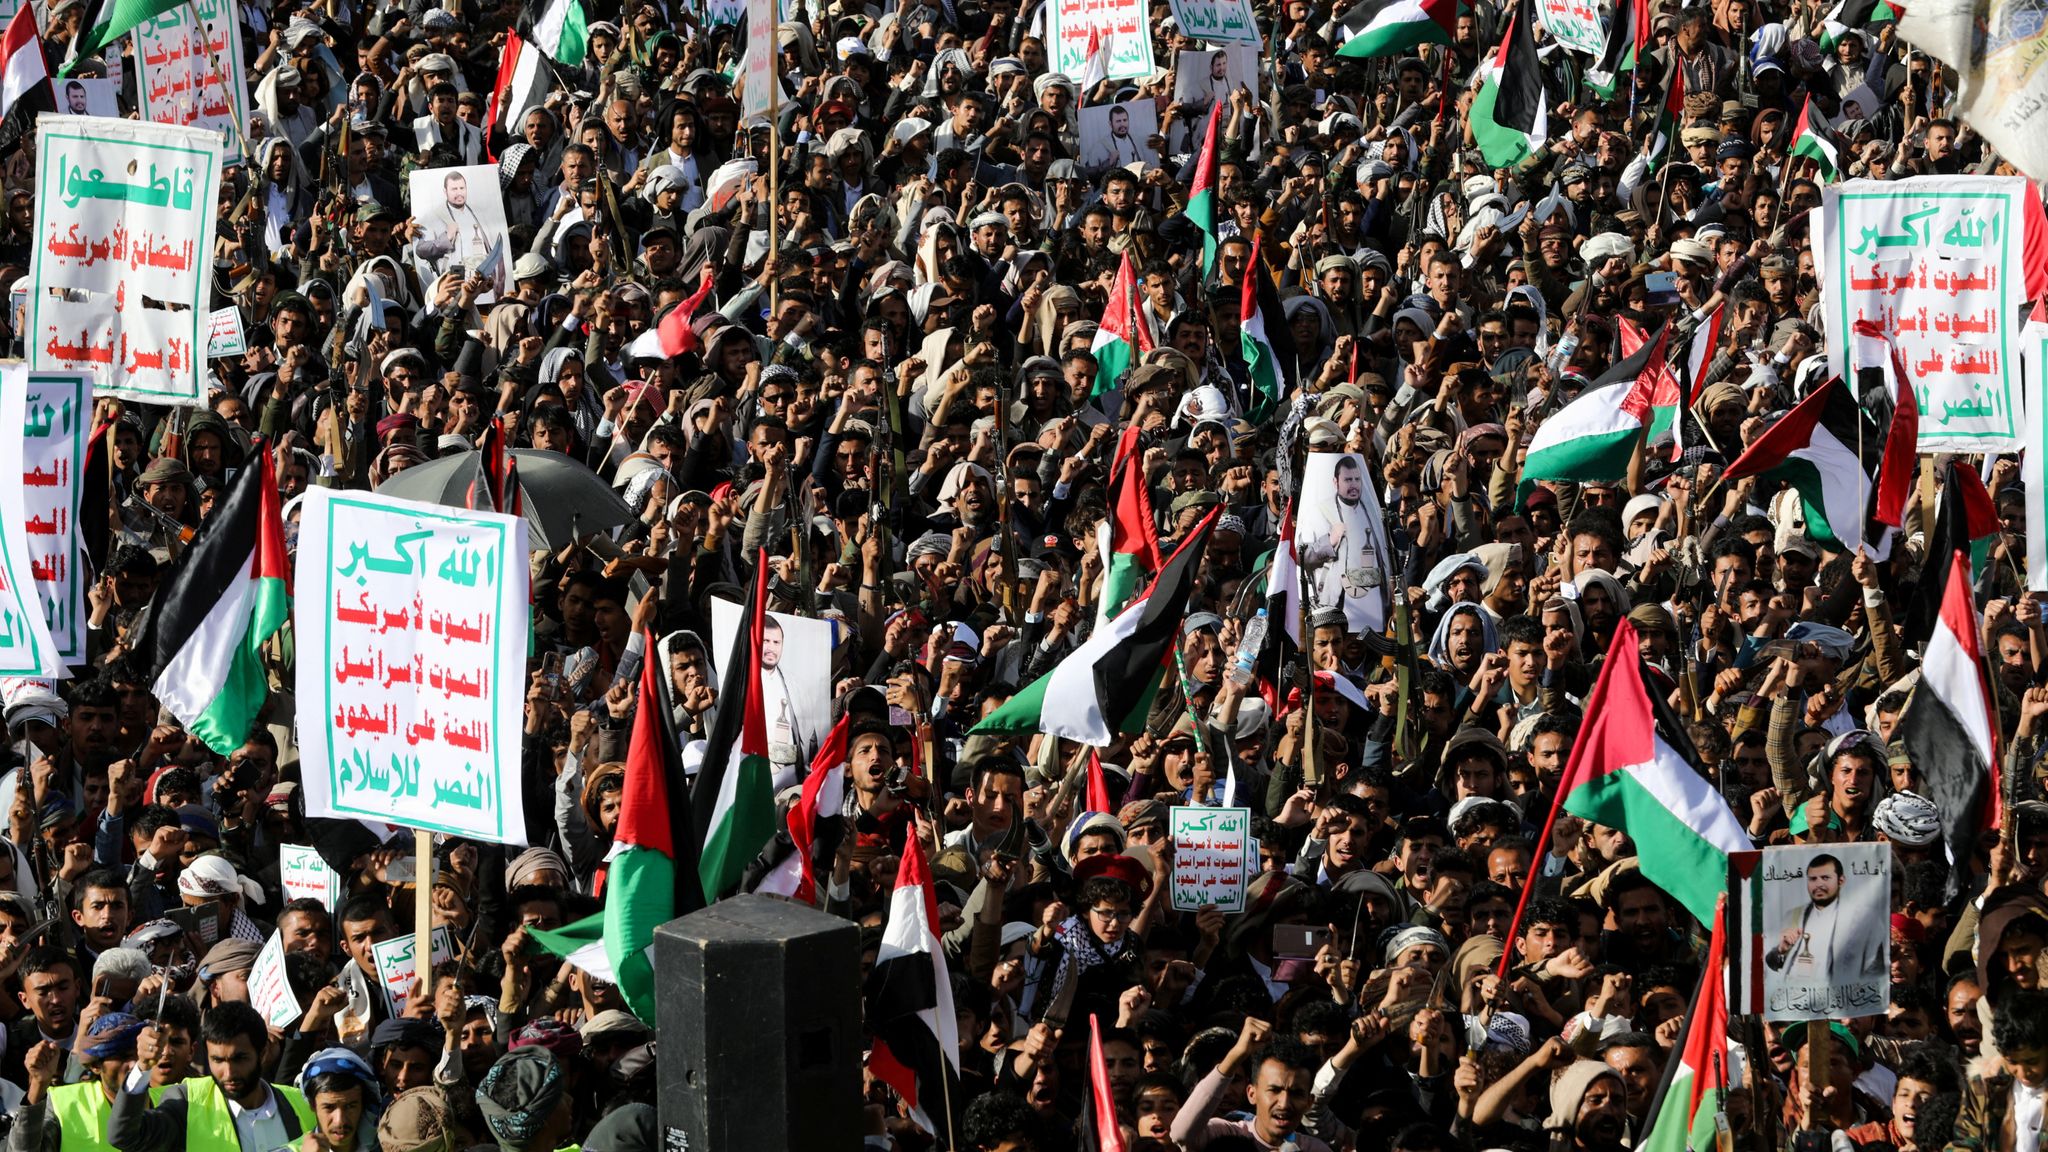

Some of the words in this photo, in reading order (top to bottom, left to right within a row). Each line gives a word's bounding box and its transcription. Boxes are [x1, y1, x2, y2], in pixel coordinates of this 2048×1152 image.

[1221, 7, 1248, 34] النصر
[192, 30, 229, 59] الموت
[194, 62, 231, 90] الموت
[59, 153, 194, 210] قاطعوا
[48, 219, 129, 267] الأمريكية
[1848, 201, 1940, 261] أكبر
[1944, 207, 1999, 248] الله
[131, 229, 193, 277] البضائع
[1850, 257, 1927, 296] لأمريكا
[1933, 264, 1996, 297] الموت
[114, 280, 125, 313] و
[1934, 306, 1996, 339] الموت
[46, 325, 190, 378] الإسرائيلية
[1914, 347, 1944, 378] على
[1951, 347, 1998, 375] اللعنة
[1938, 383, 2002, 425] النصر
[23, 458, 67, 487] الم
[26, 507, 66, 535] الم
[32, 553, 64, 582] اللع
[336, 522, 434, 587] أكبر
[438, 535, 495, 588] الله
[337, 589, 424, 635] لأمريكا
[430, 608, 490, 645] الموت
[335, 645, 424, 695] لإسرائيل
[430, 665, 488, 700] الموت
[335, 701, 397, 741] اليهود
[406, 708, 436, 746] على
[443, 711, 489, 753] اللعنة
[339, 746, 421, 811] للإسلام
[430, 762, 492, 811] النصر
[1177, 812, 1217, 836] أكبر
[1218, 815, 1243, 832] الله
[1176, 836, 1211, 851] لأمريكا
[1214, 839, 1242, 852] الموت
[1176, 855, 1211, 870] لإسرائيل
[1214, 856, 1242, 870] الموت
[1220, 873, 1241, 885] اللعنة
[1176, 874, 1200, 886] اليهود
[1203, 874, 1216, 887] على
[1214, 889, 1240, 904] النصر
[1177, 889, 1209, 908] للإسلام
